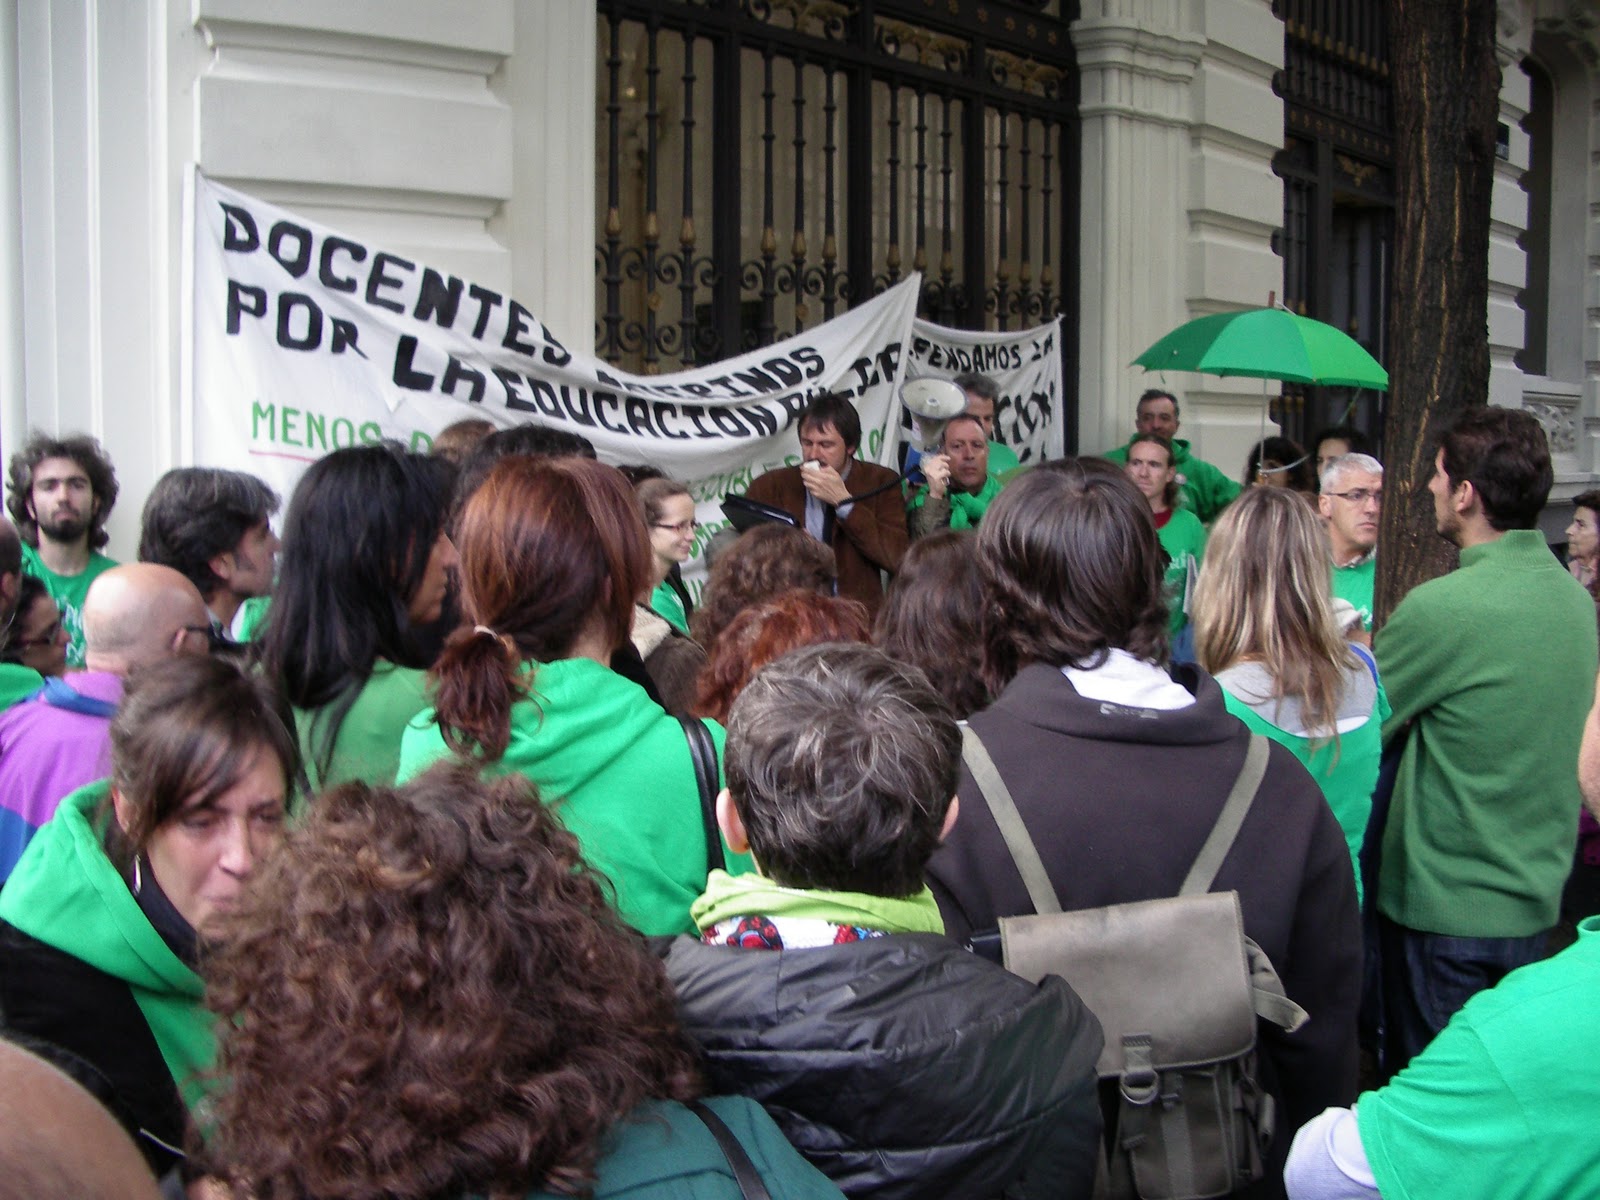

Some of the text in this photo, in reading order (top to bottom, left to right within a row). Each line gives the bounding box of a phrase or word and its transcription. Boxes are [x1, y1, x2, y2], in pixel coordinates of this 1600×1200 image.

[218, 201, 572, 367] DOCENTES
[226, 279, 369, 359] POR
[490, 367, 779, 440] EDUCACION
[251, 400, 384, 450] MENOS
